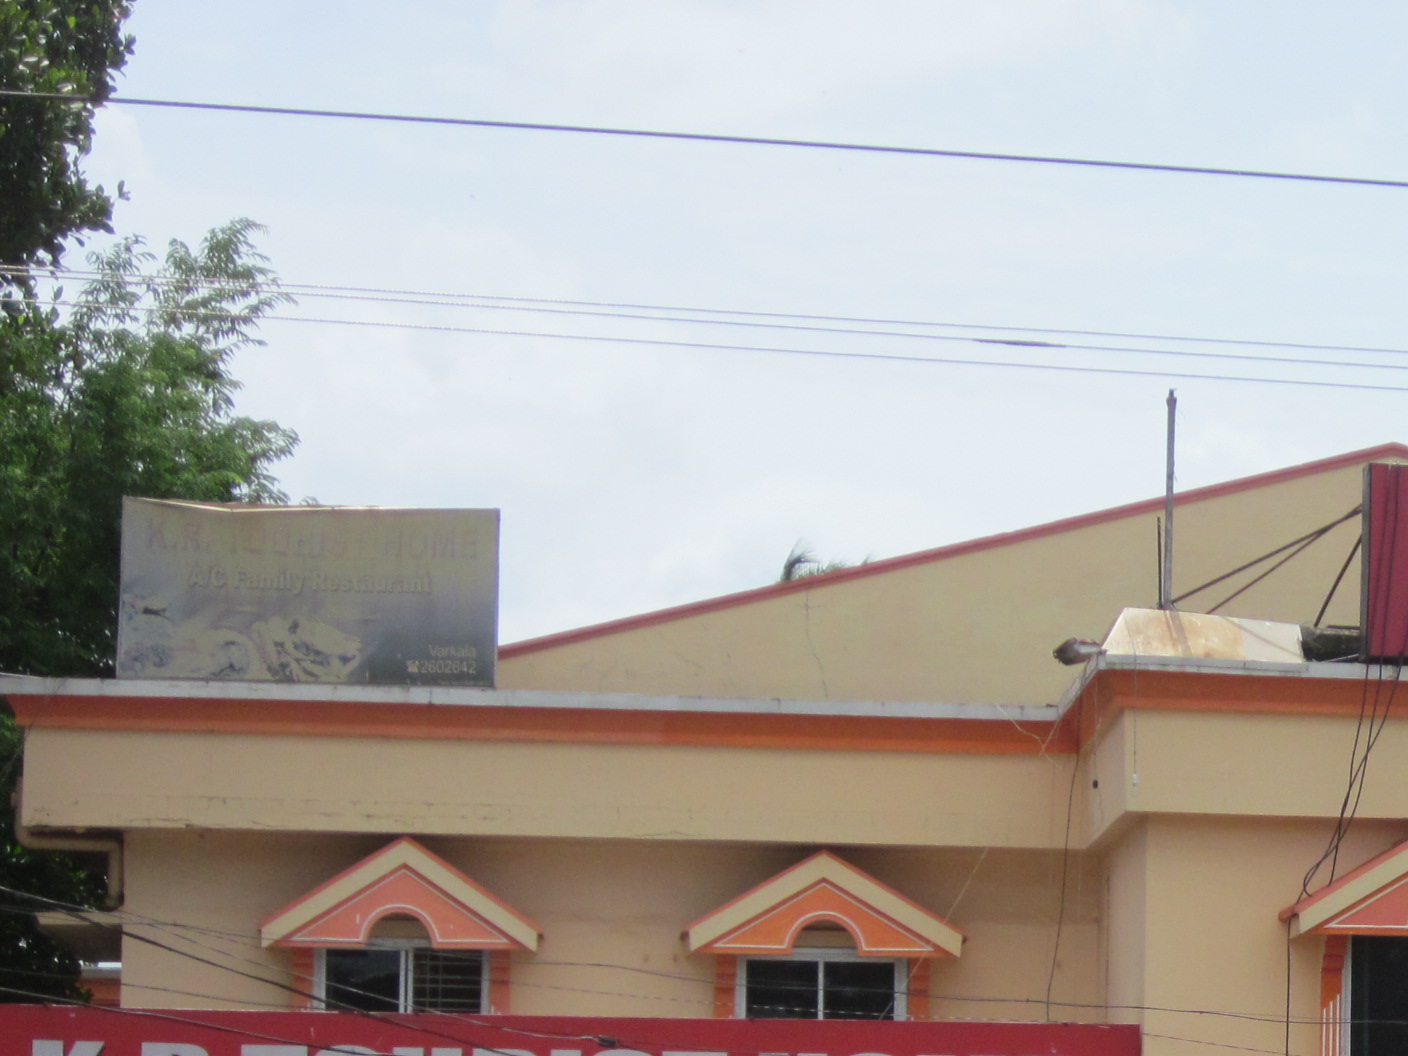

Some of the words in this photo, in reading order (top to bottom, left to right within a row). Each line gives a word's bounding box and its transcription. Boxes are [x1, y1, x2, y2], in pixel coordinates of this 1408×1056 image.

[233, 569, 306, 596] Family
[311, 571, 434, 594] Restaurant
[428, 644, 477, 658] Varkala
